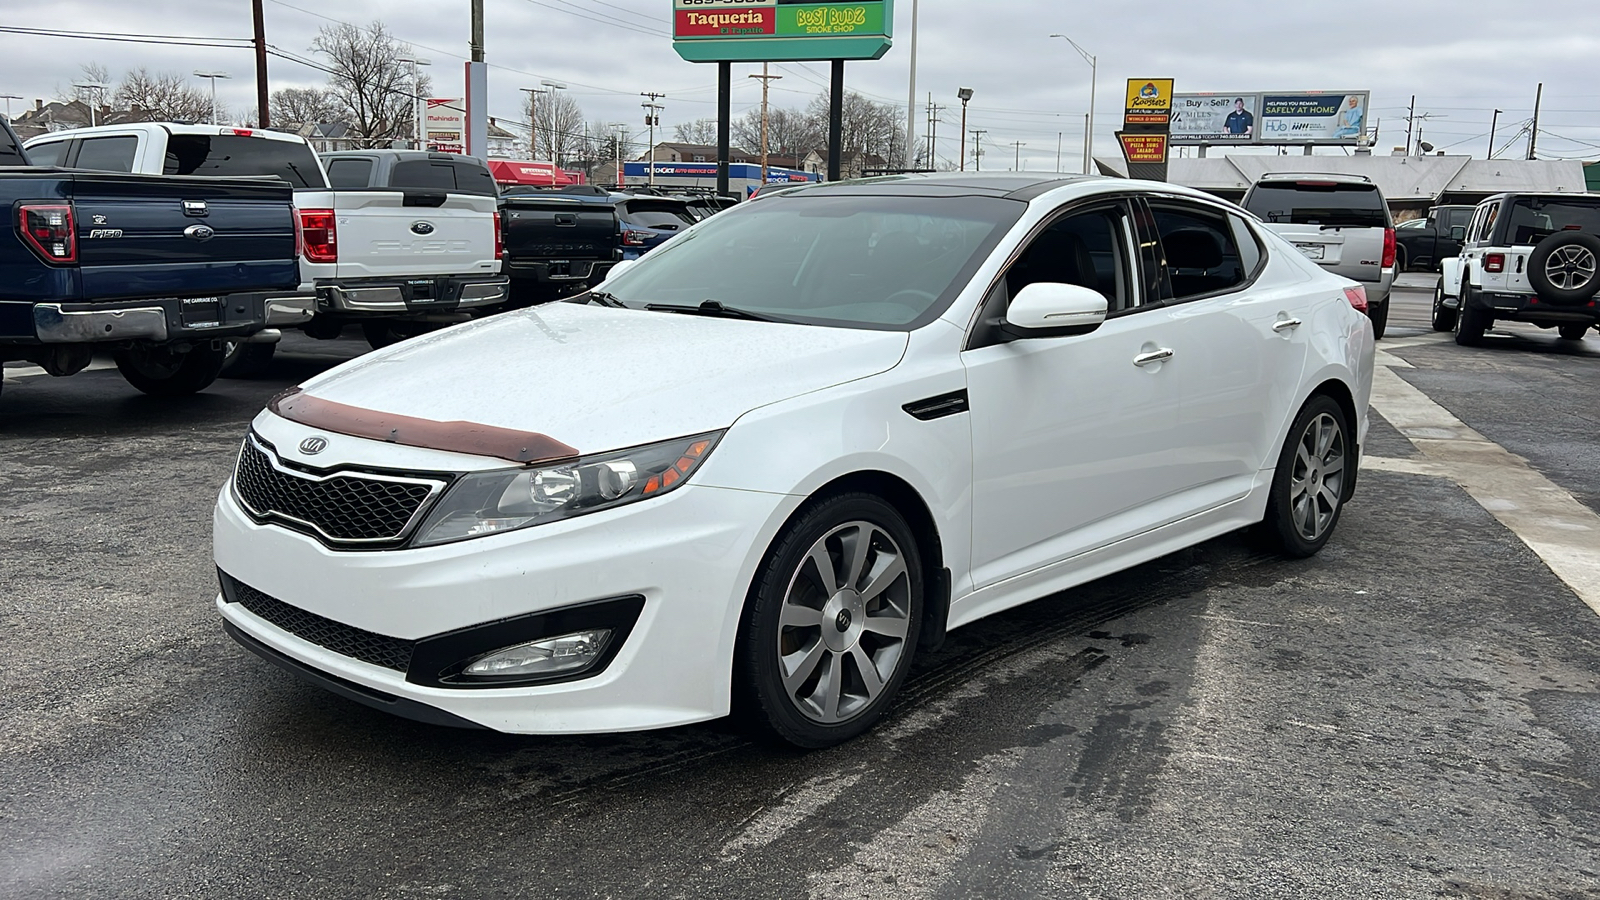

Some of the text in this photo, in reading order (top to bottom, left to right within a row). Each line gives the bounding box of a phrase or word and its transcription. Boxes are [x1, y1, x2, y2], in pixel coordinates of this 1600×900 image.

[829, 6, 866, 25] BUDZ
[806, 25, 855, 33] SMOKE SHOP
[1131, 96, 1167, 108] Roosters
[1186, 99, 1202, 108] Buy
[1210, 99, 1230, 107] Sell?
[1309, 106, 1335, 114] HOME
[301, 438, 323, 451] KIA
